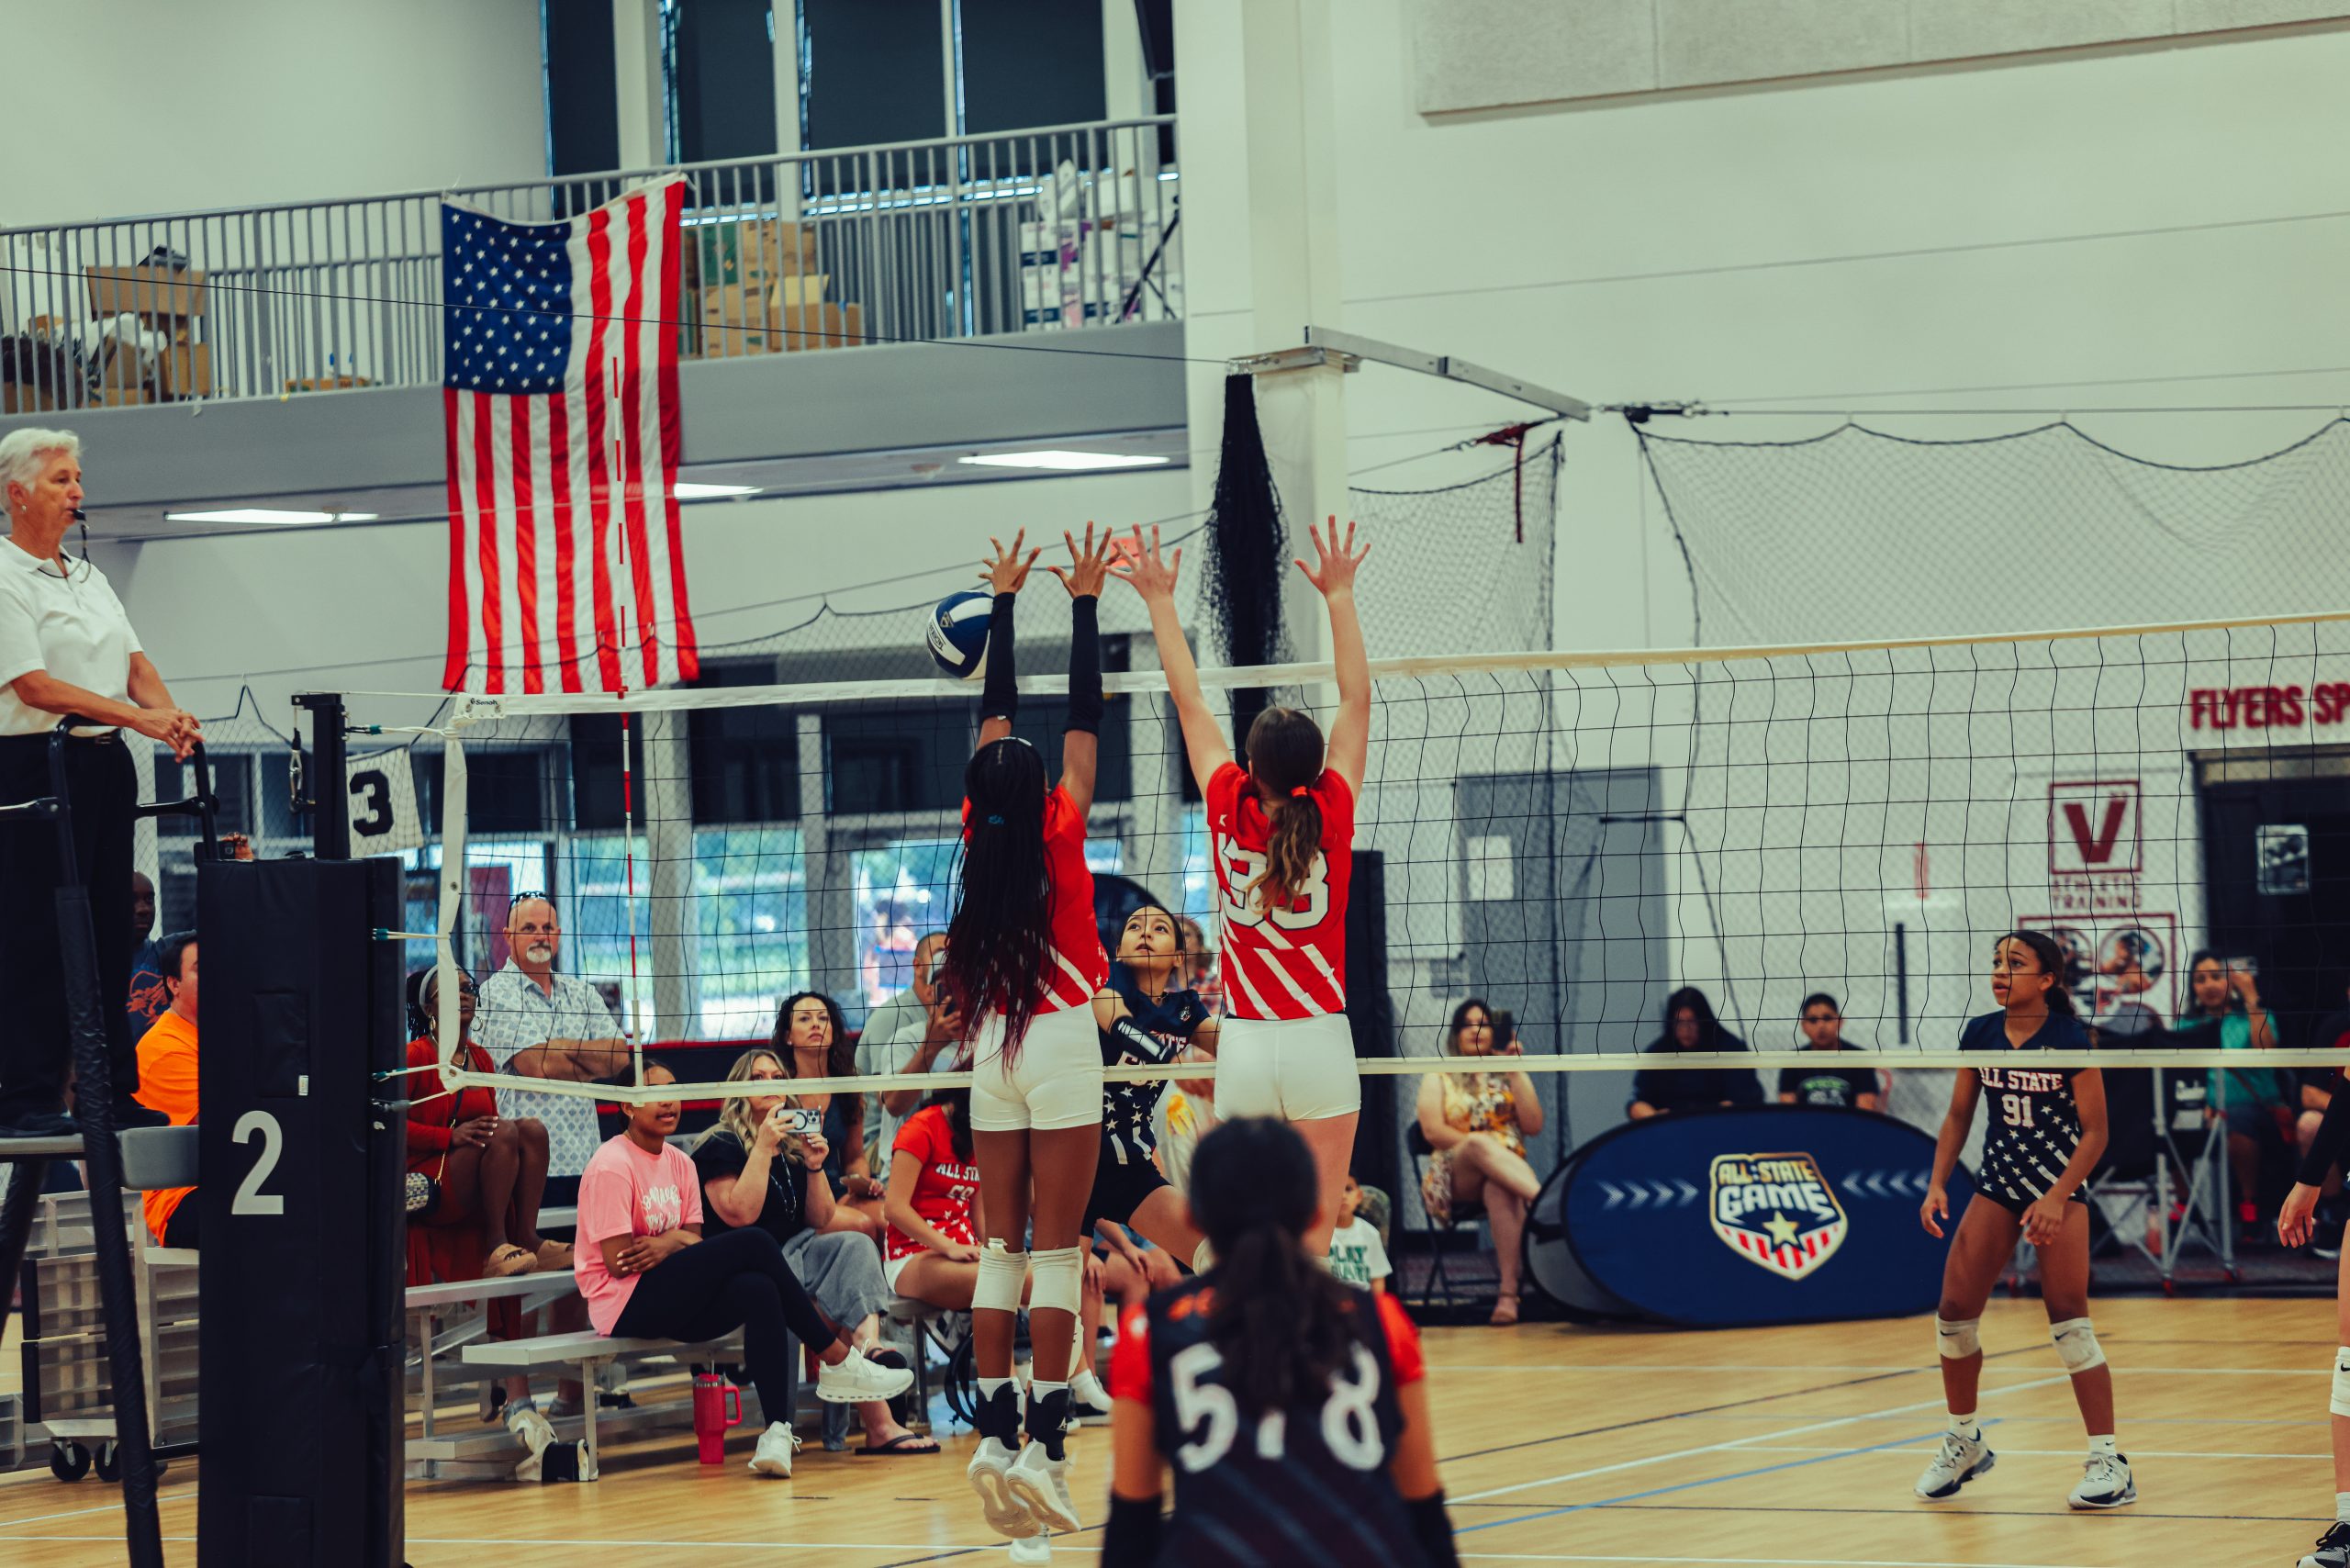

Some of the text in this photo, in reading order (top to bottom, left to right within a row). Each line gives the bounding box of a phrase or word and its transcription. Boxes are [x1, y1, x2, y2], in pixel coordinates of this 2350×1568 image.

[2190, 685, 2304, 729] FLYERS
[350, 769, 395, 836] 3
[2063, 801, 2128, 863] V
[2053, 893, 2142, 910] TRAINING
[2008, 1070, 2064, 1092] STATE
[2001, 1093, 2036, 1129] 91
[232, 1111, 284, 1215] 2
[935, 1162, 980, 1182] ALL STA
